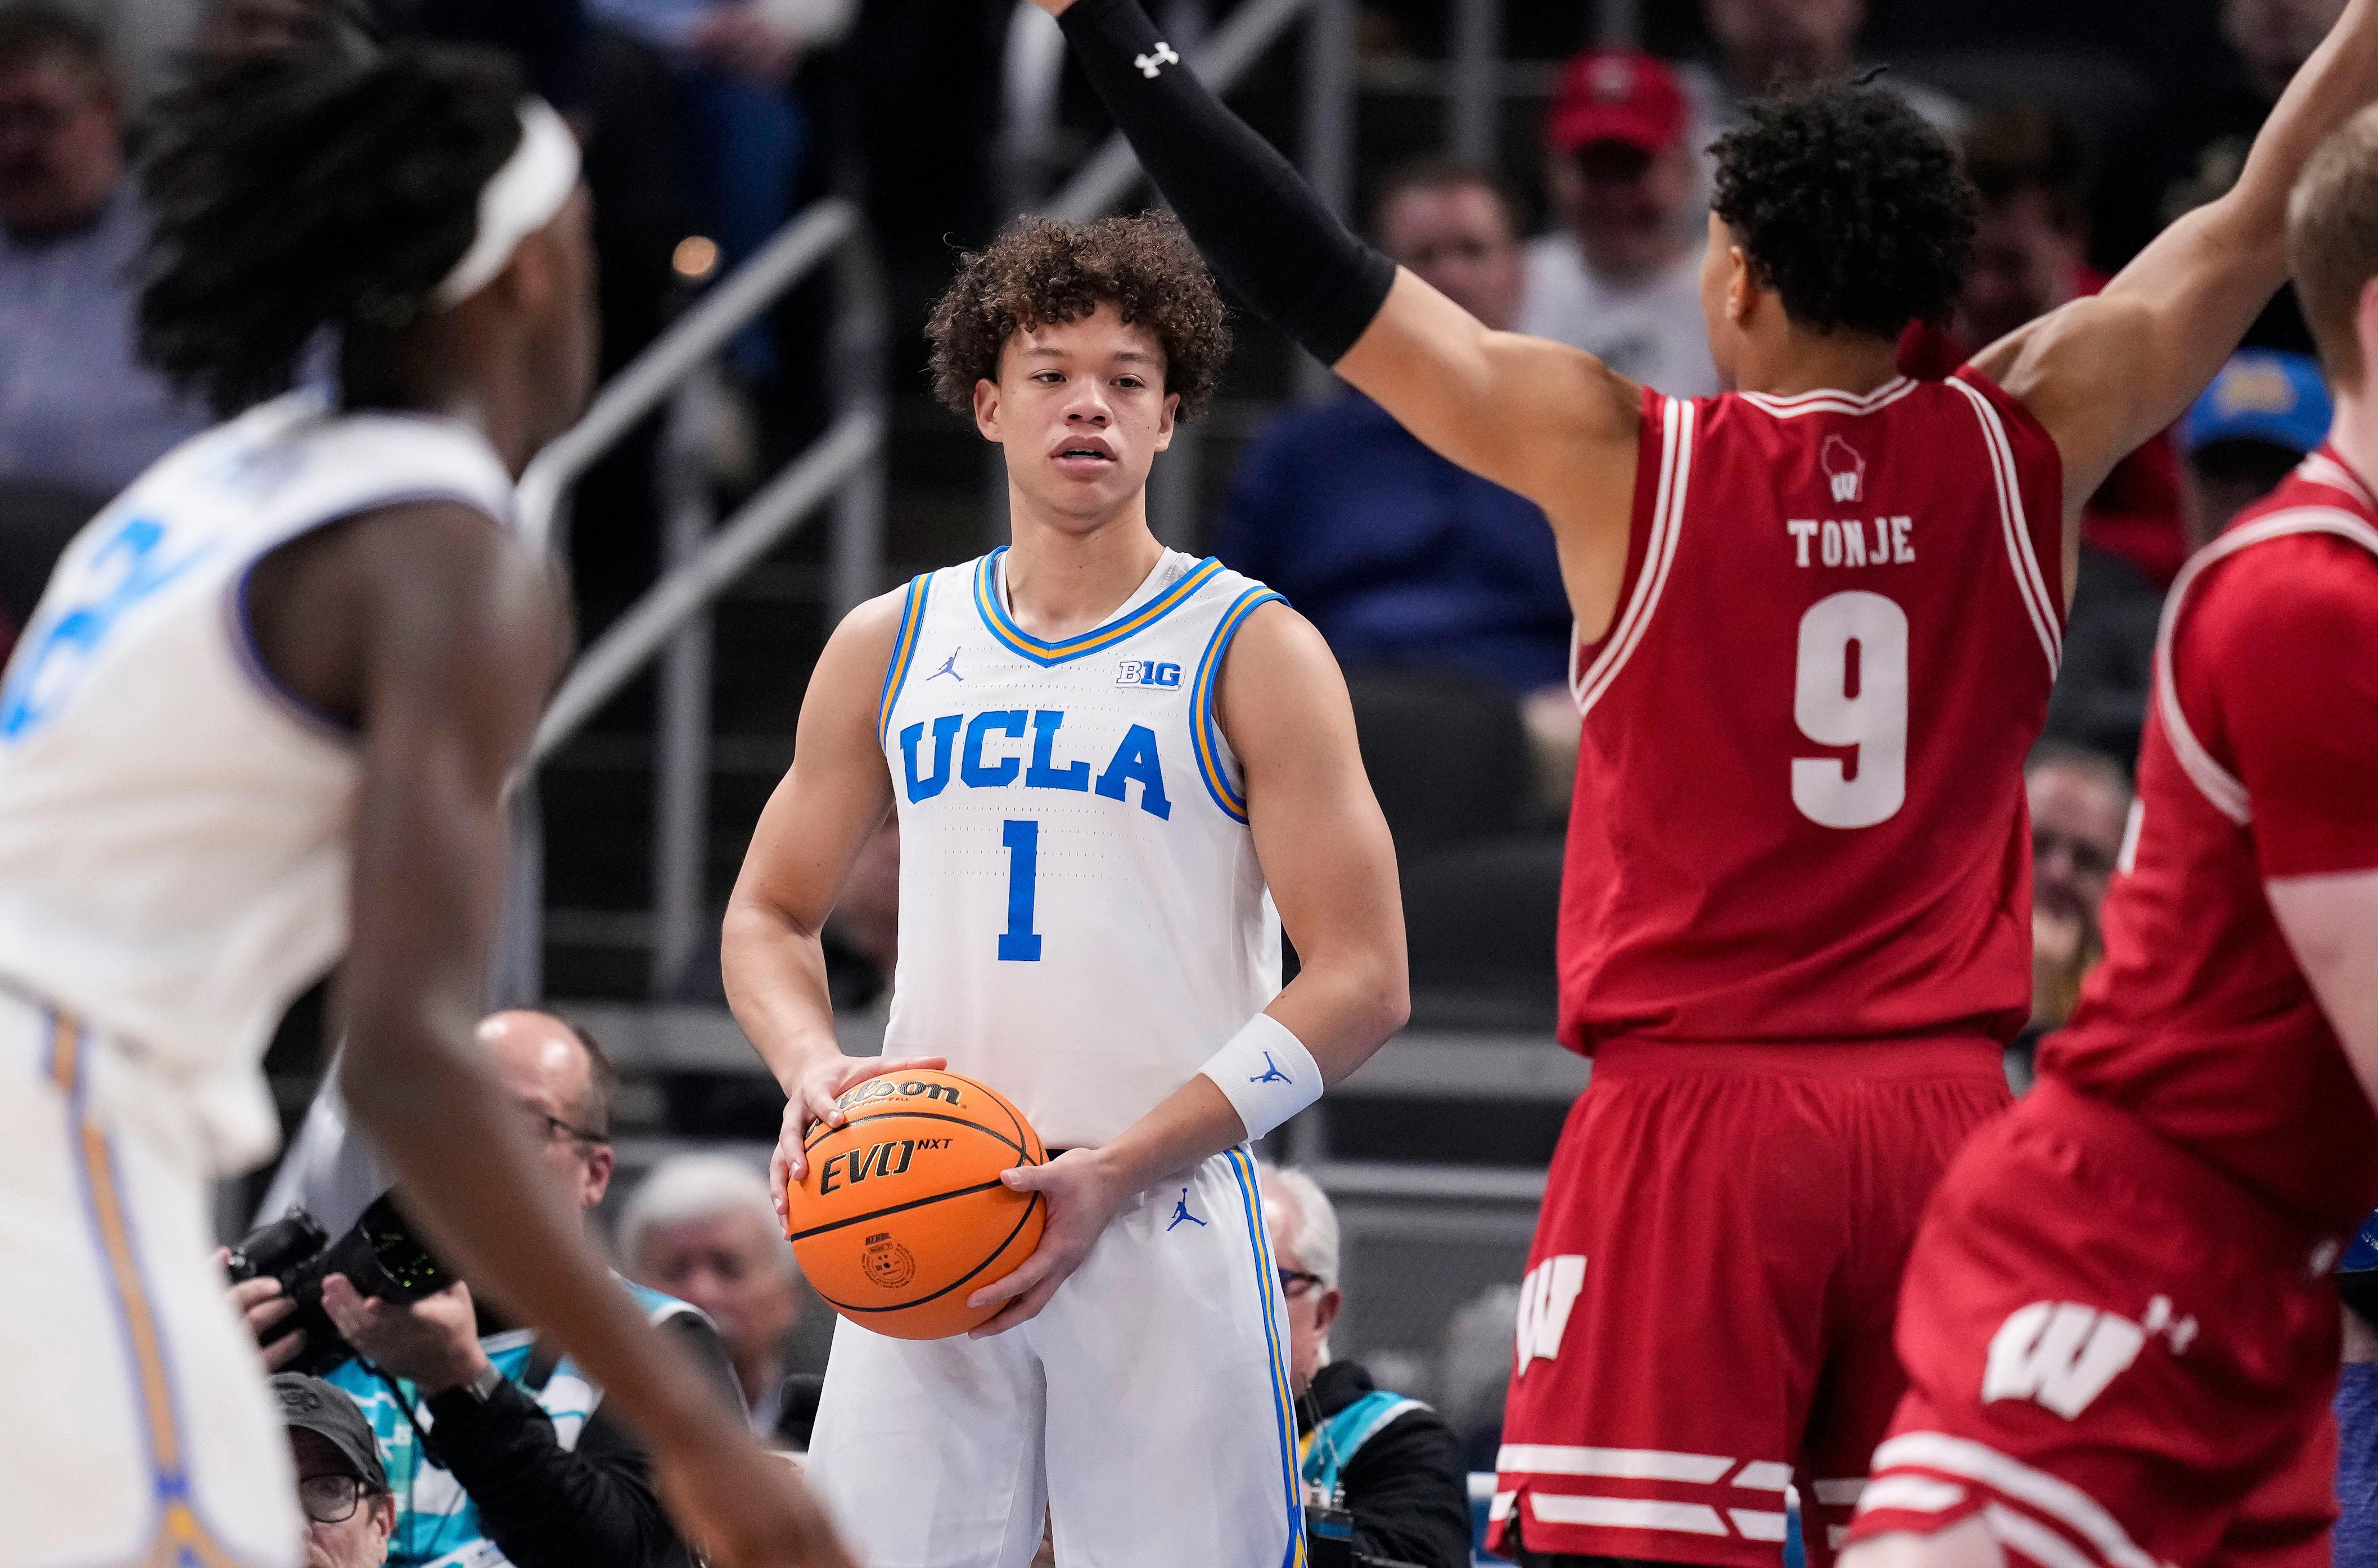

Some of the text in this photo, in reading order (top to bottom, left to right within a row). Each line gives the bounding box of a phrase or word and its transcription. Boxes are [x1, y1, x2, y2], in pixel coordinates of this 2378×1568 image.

[1787, 516, 1915, 567] TONJE
[900, 710, 1172, 821] UCLA
[1791, 590, 1909, 830] 9
[998, 820, 1041, 961] 1
[820, 1138, 953, 1196] EVO NXT
[1516, 1254, 1587, 1378] W
[1980, 1300, 2146, 1421] W
